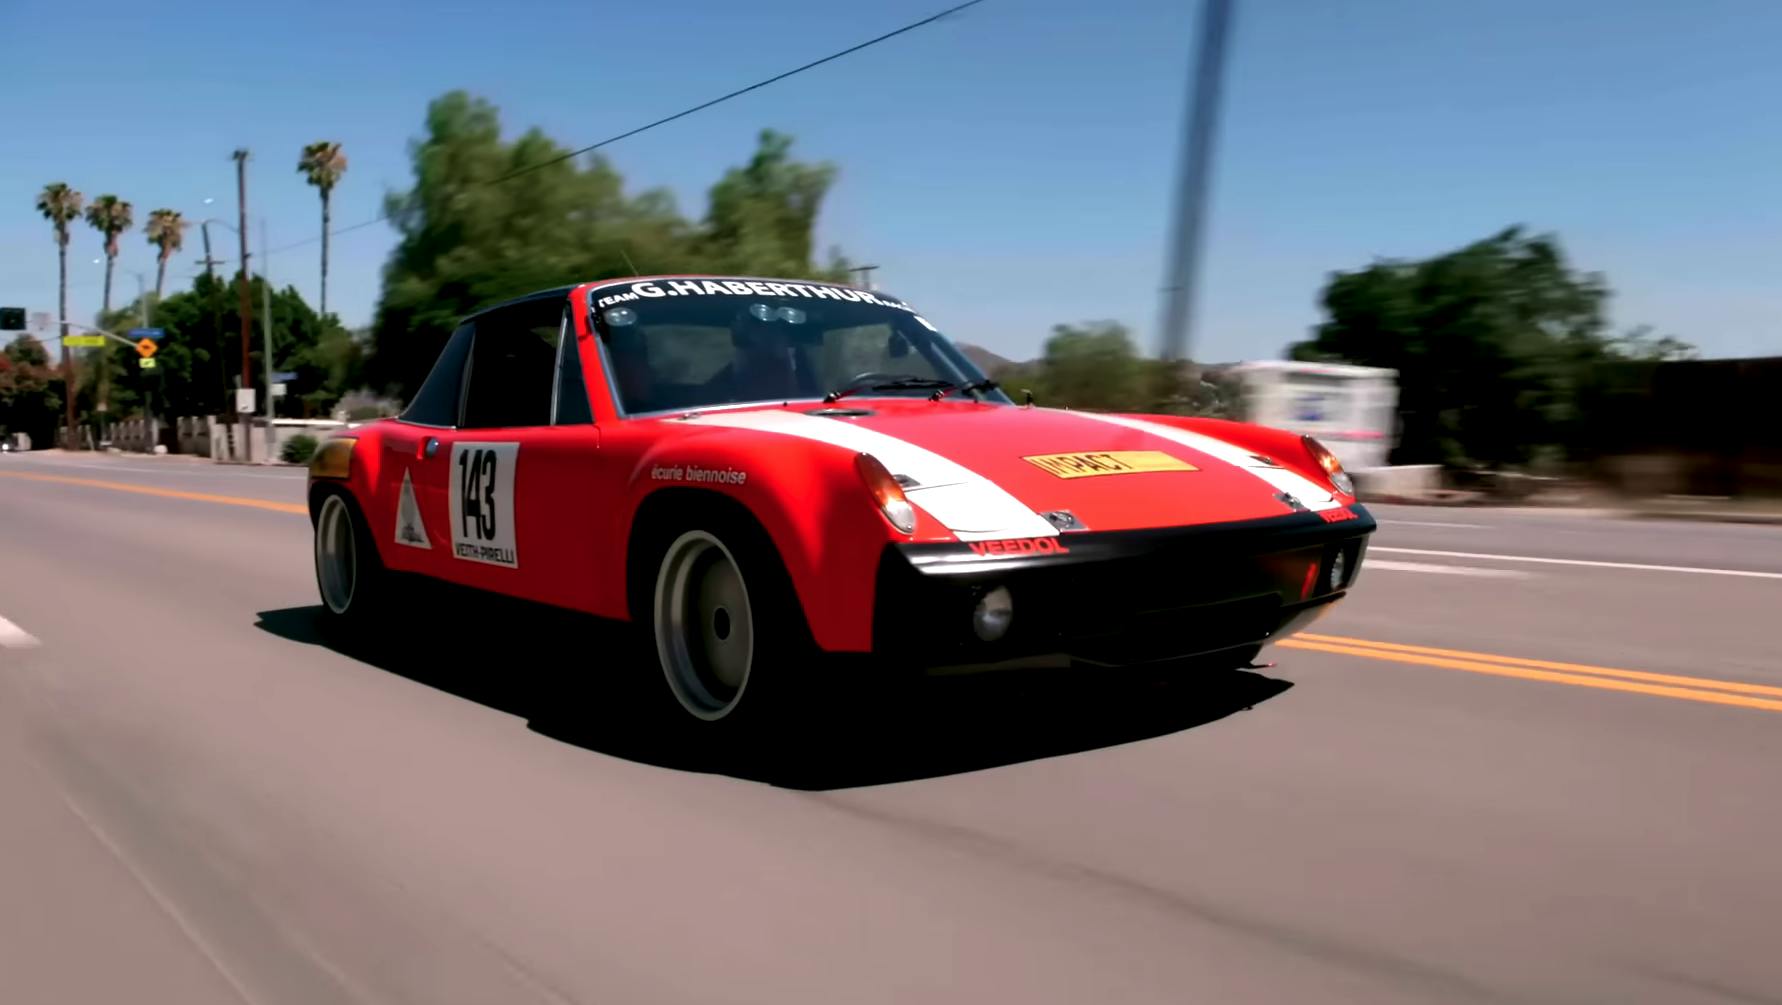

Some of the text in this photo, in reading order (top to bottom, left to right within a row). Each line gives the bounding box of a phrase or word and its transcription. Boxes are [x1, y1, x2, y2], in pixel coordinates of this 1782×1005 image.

[598, 292, 640, 308] TEAM
[1030, 454, 1133, 474] IMPACT
[686, 465, 746, 485] biennoise
[459, 449, 497, 540] 143
[455, 543, 515, 564] VEITH-PIRELLI
[968, 537, 1070, 557] VEEDOL
